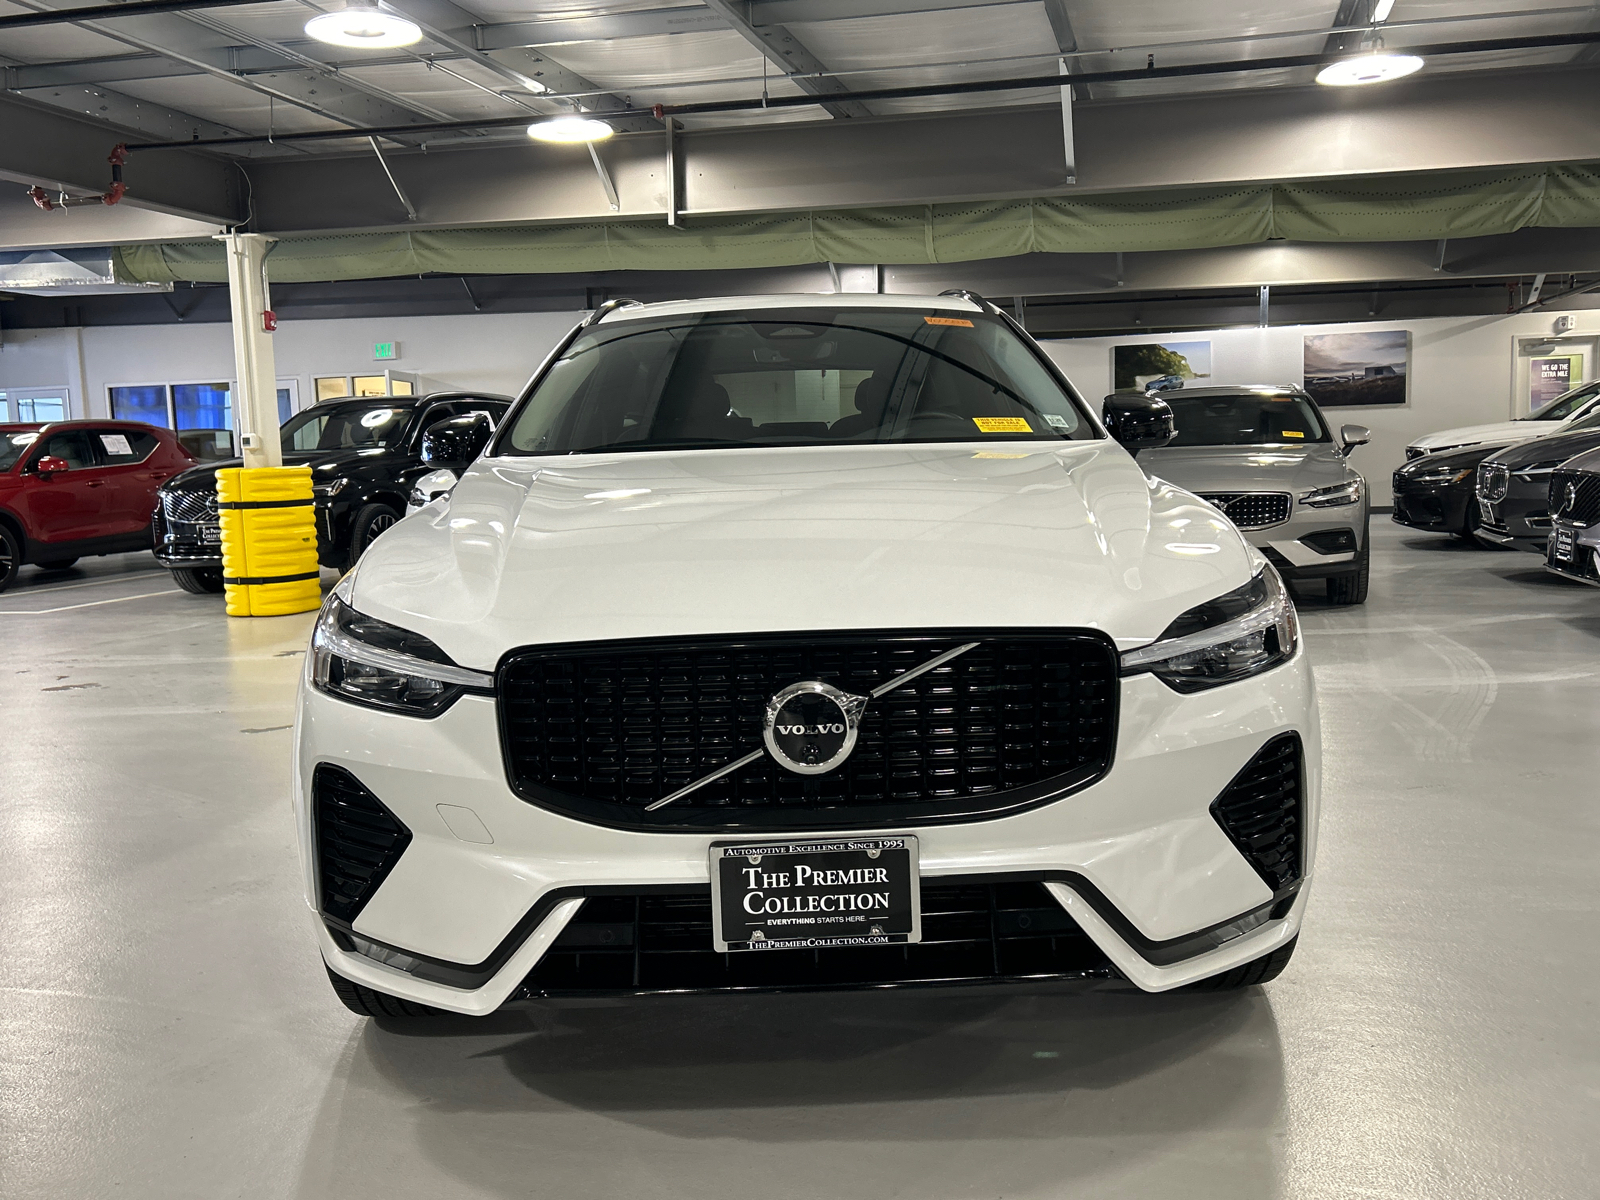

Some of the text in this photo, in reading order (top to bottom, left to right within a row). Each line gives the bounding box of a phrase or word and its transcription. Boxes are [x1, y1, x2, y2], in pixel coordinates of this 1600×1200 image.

[375, 343, 391, 358] EXIT
[776, 723, 844, 735] VOLVO
[726, 839, 903, 856] AUTOMOTIVE EXCELLENCE SINCE 1995
[742, 865, 889, 889] THE PREMIER
[743, 891, 890, 914] COLLECTION
[767, 917, 816, 926] EVERYTHING
[816, 916, 844, 924] STARTS
